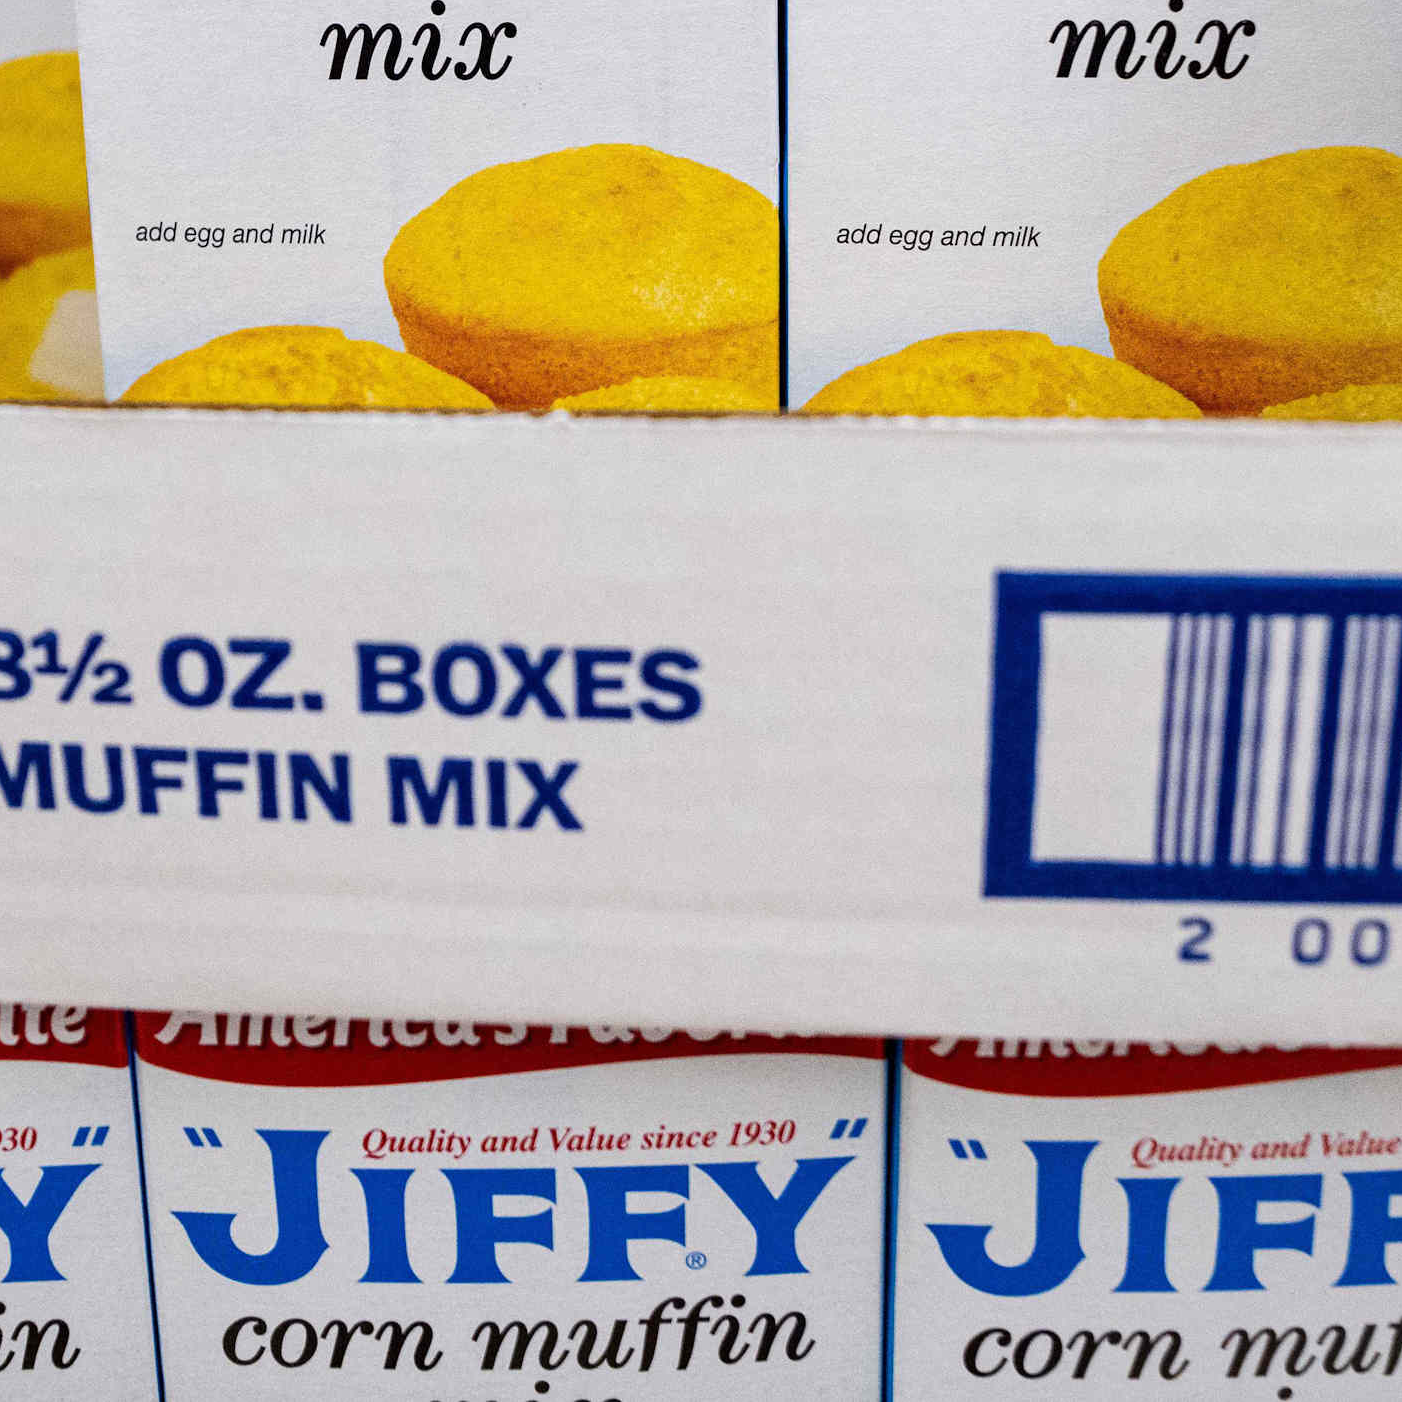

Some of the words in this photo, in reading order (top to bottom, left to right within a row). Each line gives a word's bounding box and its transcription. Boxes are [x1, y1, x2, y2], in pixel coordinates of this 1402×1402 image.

[318, 0, 518, 82] mix
[135, 222, 178, 242] add
[184, 226, 225, 248] egg
[231, 223, 274, 244] and
[281, 223, 326, 244] milk
[836, 223, 883, 244] add
[889, 229, 934, 251] egg
[940, 226, 986, 247] and
[992, 226, 1041, 248] milk
[158, 633, 325, 712] OZ.
[355, 640, 704, 724] BOXES
[386, 755, 586, 832] MIX
[1175, 916, 1217, 967] 2
[1288, 916, 1393, 968] 00
[360, 1126, 473, 1161] Quality
[479, 1127, 540, 1154] and
[547, 1125, 633, 1154] Value
[639, 1120, 720, 1150] since
[727, 1117, 798, 1149] 1930
[1129, 1134, 1246, 1170] Quality
[1250, 1133, 1311, 1161] and
[1320, 1130, 1402, 1157] Value
[219, 1311, 445, 1373] corn
[470, 1291, 818, 1375] muffin
[960, 1322, 1192, 1382] corn
